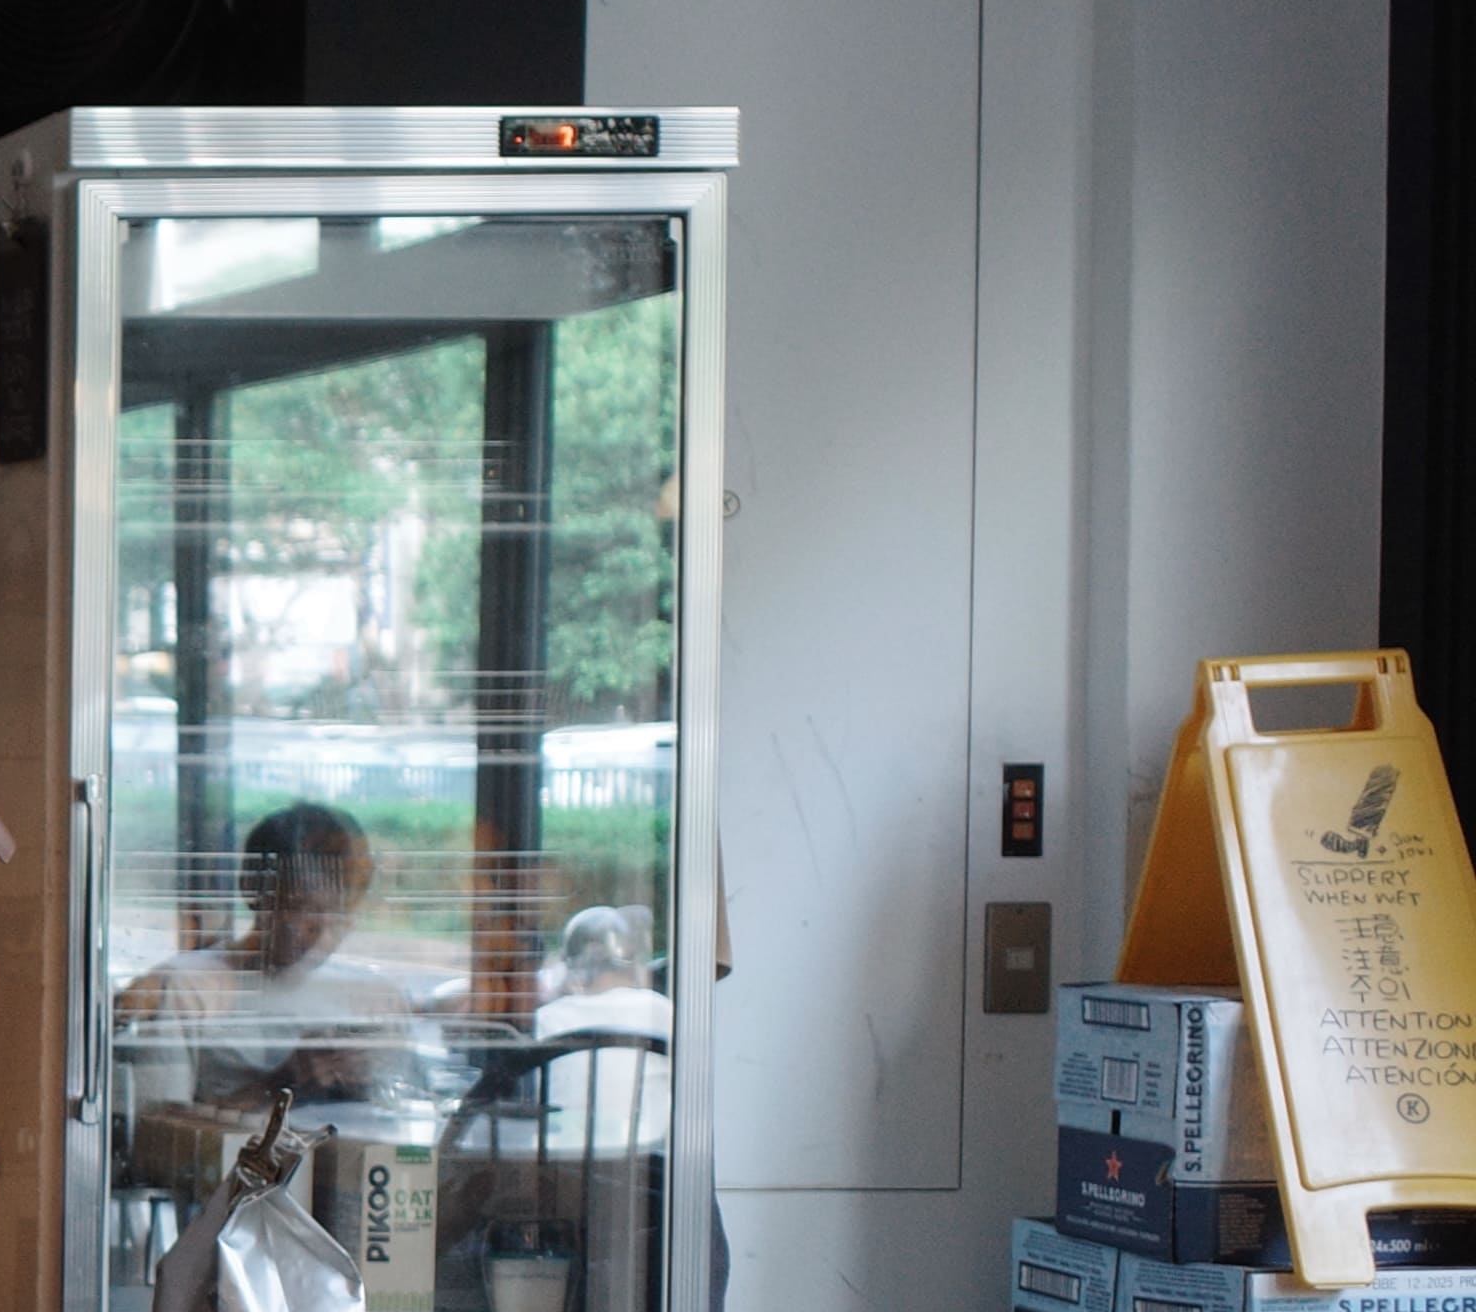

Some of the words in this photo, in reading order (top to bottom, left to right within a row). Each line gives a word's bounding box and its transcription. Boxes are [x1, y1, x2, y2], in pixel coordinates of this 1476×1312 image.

[1298, 867, 1410, 887] SLIPPERY
[1304, 890, 1367, 906] WHEN
[1376, 891, 1422, 906] WET
[1321, 1008, 1472, 1032] ATTENTION
[1184, 1006, 1205, 1173] S.PELLEGRINO
[395, 1190, 433, 1206] OAT
[366, 1165, 390, 1263] PIKOO
[395, 1209, 433, 1221] MLK
